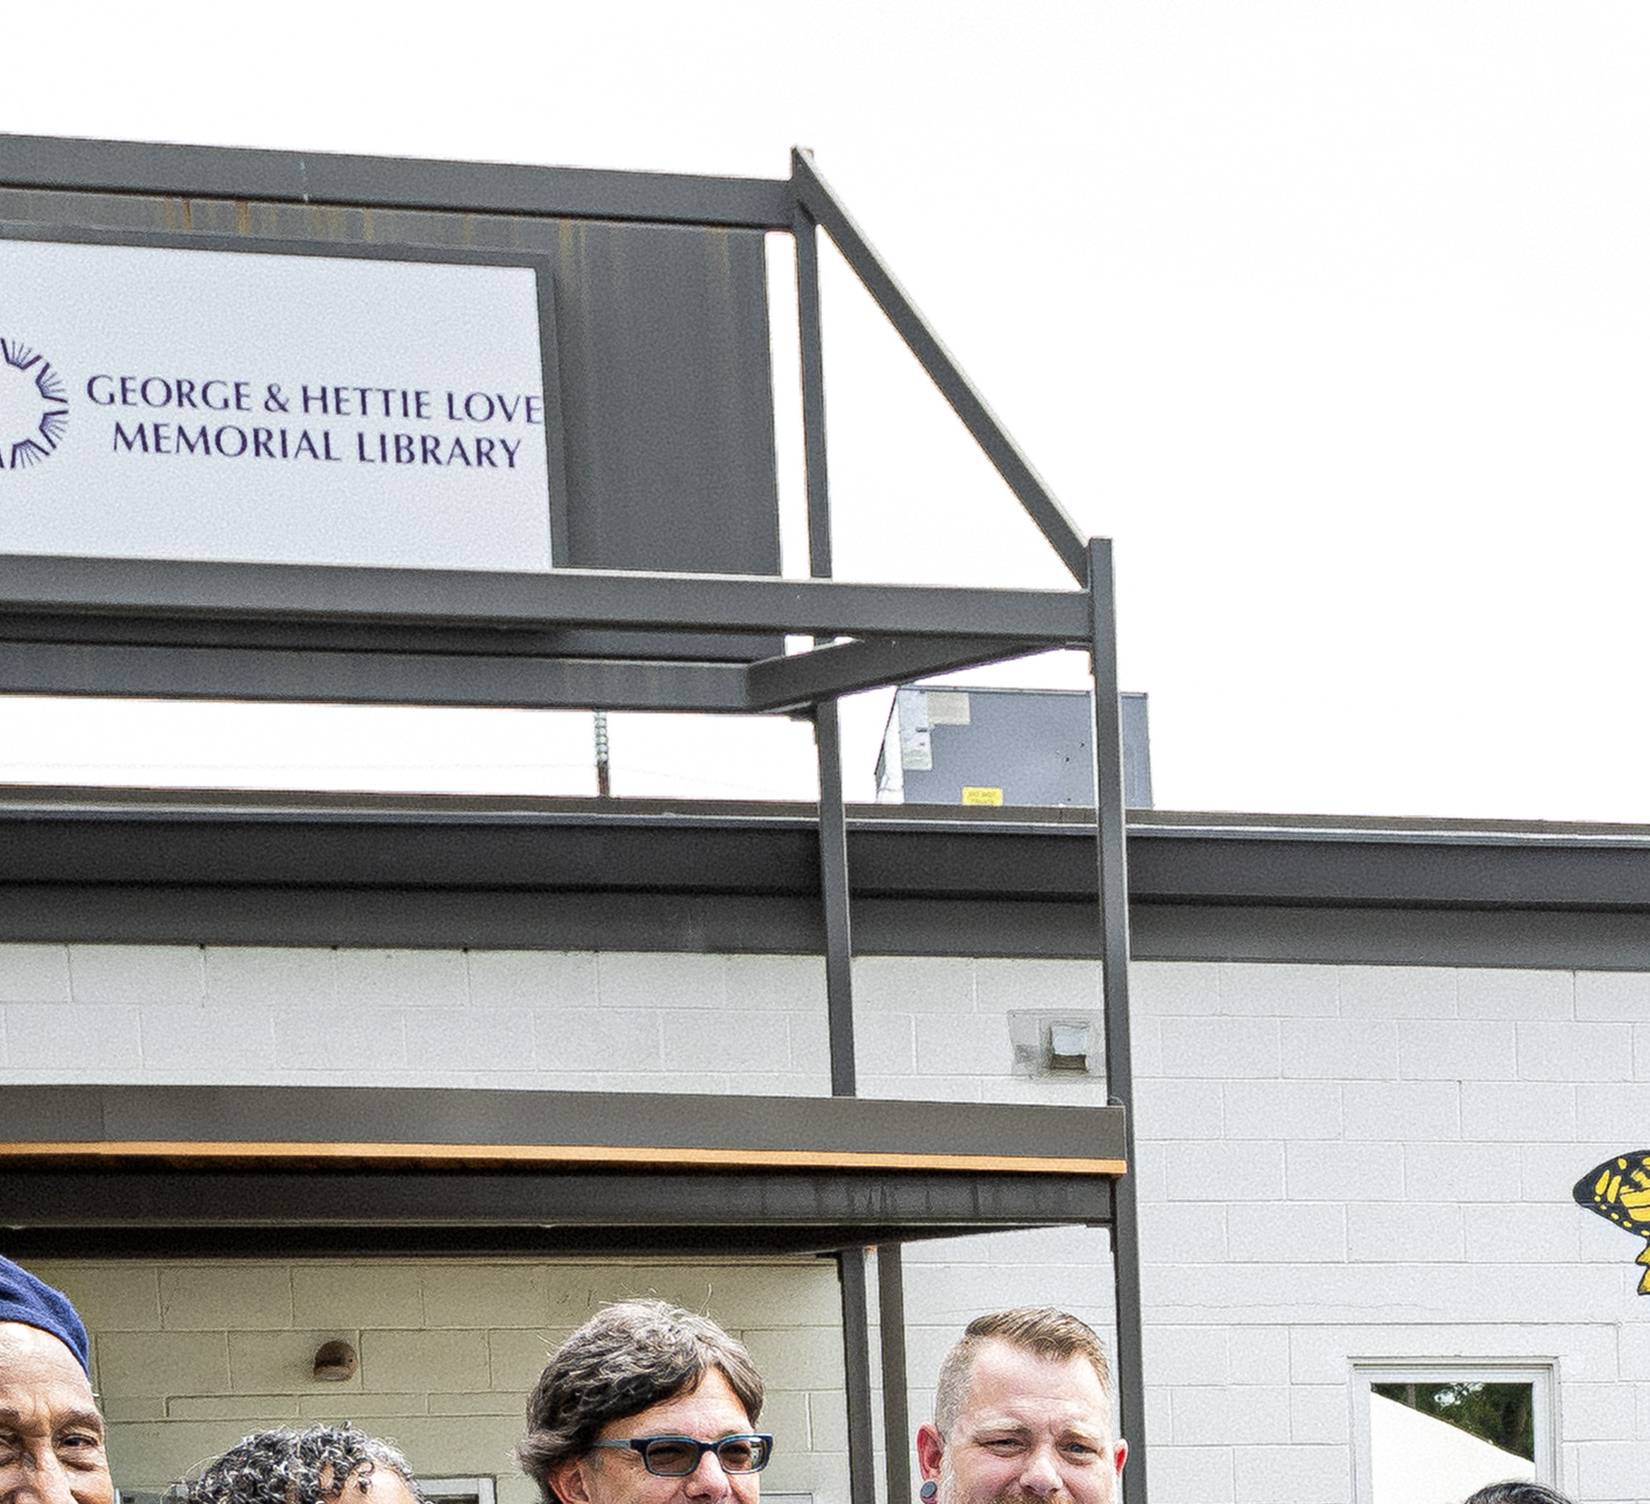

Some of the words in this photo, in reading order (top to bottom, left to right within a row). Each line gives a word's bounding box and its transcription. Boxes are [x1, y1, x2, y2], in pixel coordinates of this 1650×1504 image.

[87, 373, 252, 412] GEORGE
[263, 382, 290, 414] &
[301, 384, 432, 420] HETTIE
[447, 390, 544, 425] LOVE
[112, 420, 342, 462] MEMORIAL
[357, 430, 522, 469] LIBRARY
